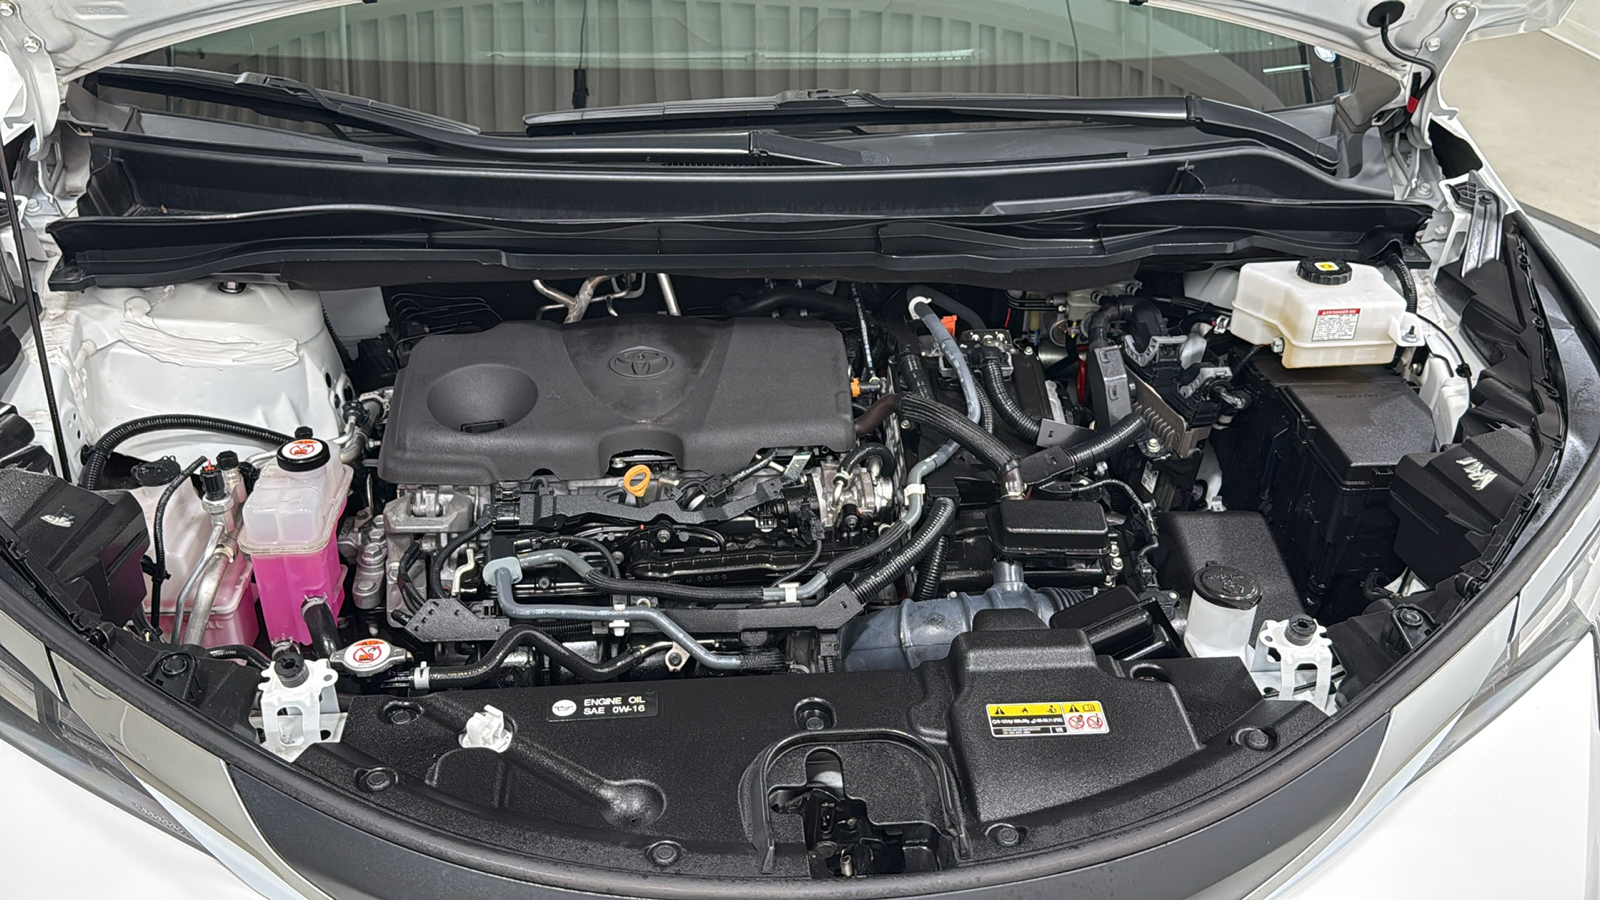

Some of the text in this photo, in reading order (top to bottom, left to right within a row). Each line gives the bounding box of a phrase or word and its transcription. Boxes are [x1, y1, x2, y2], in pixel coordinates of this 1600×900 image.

[583, 696, 646, 706] ENGINE OIL
[583, 704, 646, 716] SAE 0W-16
